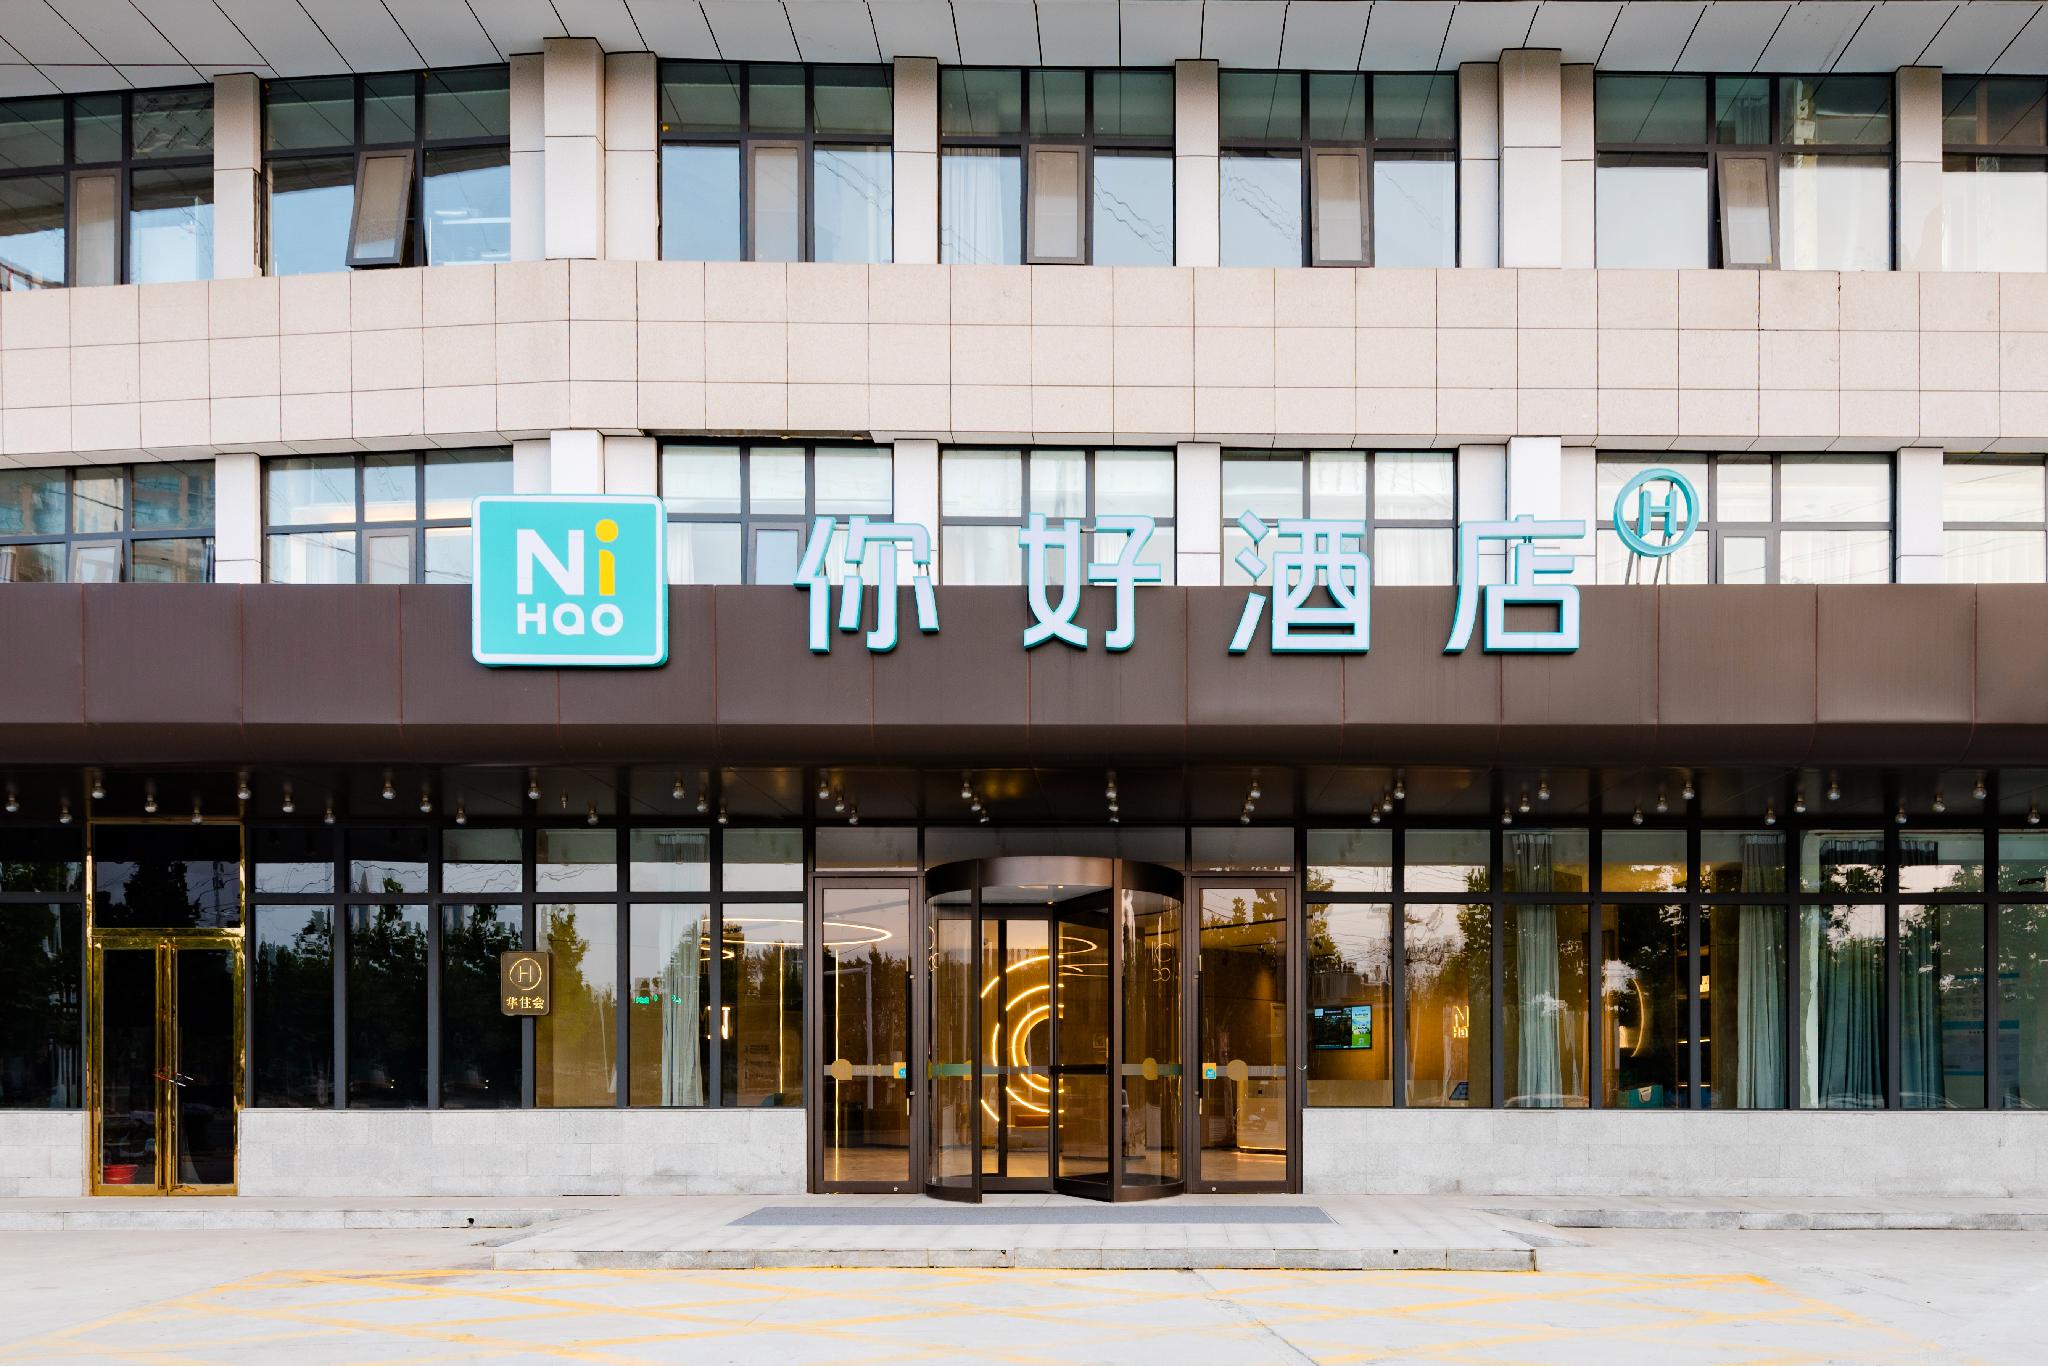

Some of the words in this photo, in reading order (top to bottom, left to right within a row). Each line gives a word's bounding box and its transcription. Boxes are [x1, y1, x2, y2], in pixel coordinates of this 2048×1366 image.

[516, 518, 618, 596] Ni
[794, 509, 1586, 654] 你好酒店
[505, 995, 545, 1010] 华住会
[1453, 1004, 1470, 1028] N
